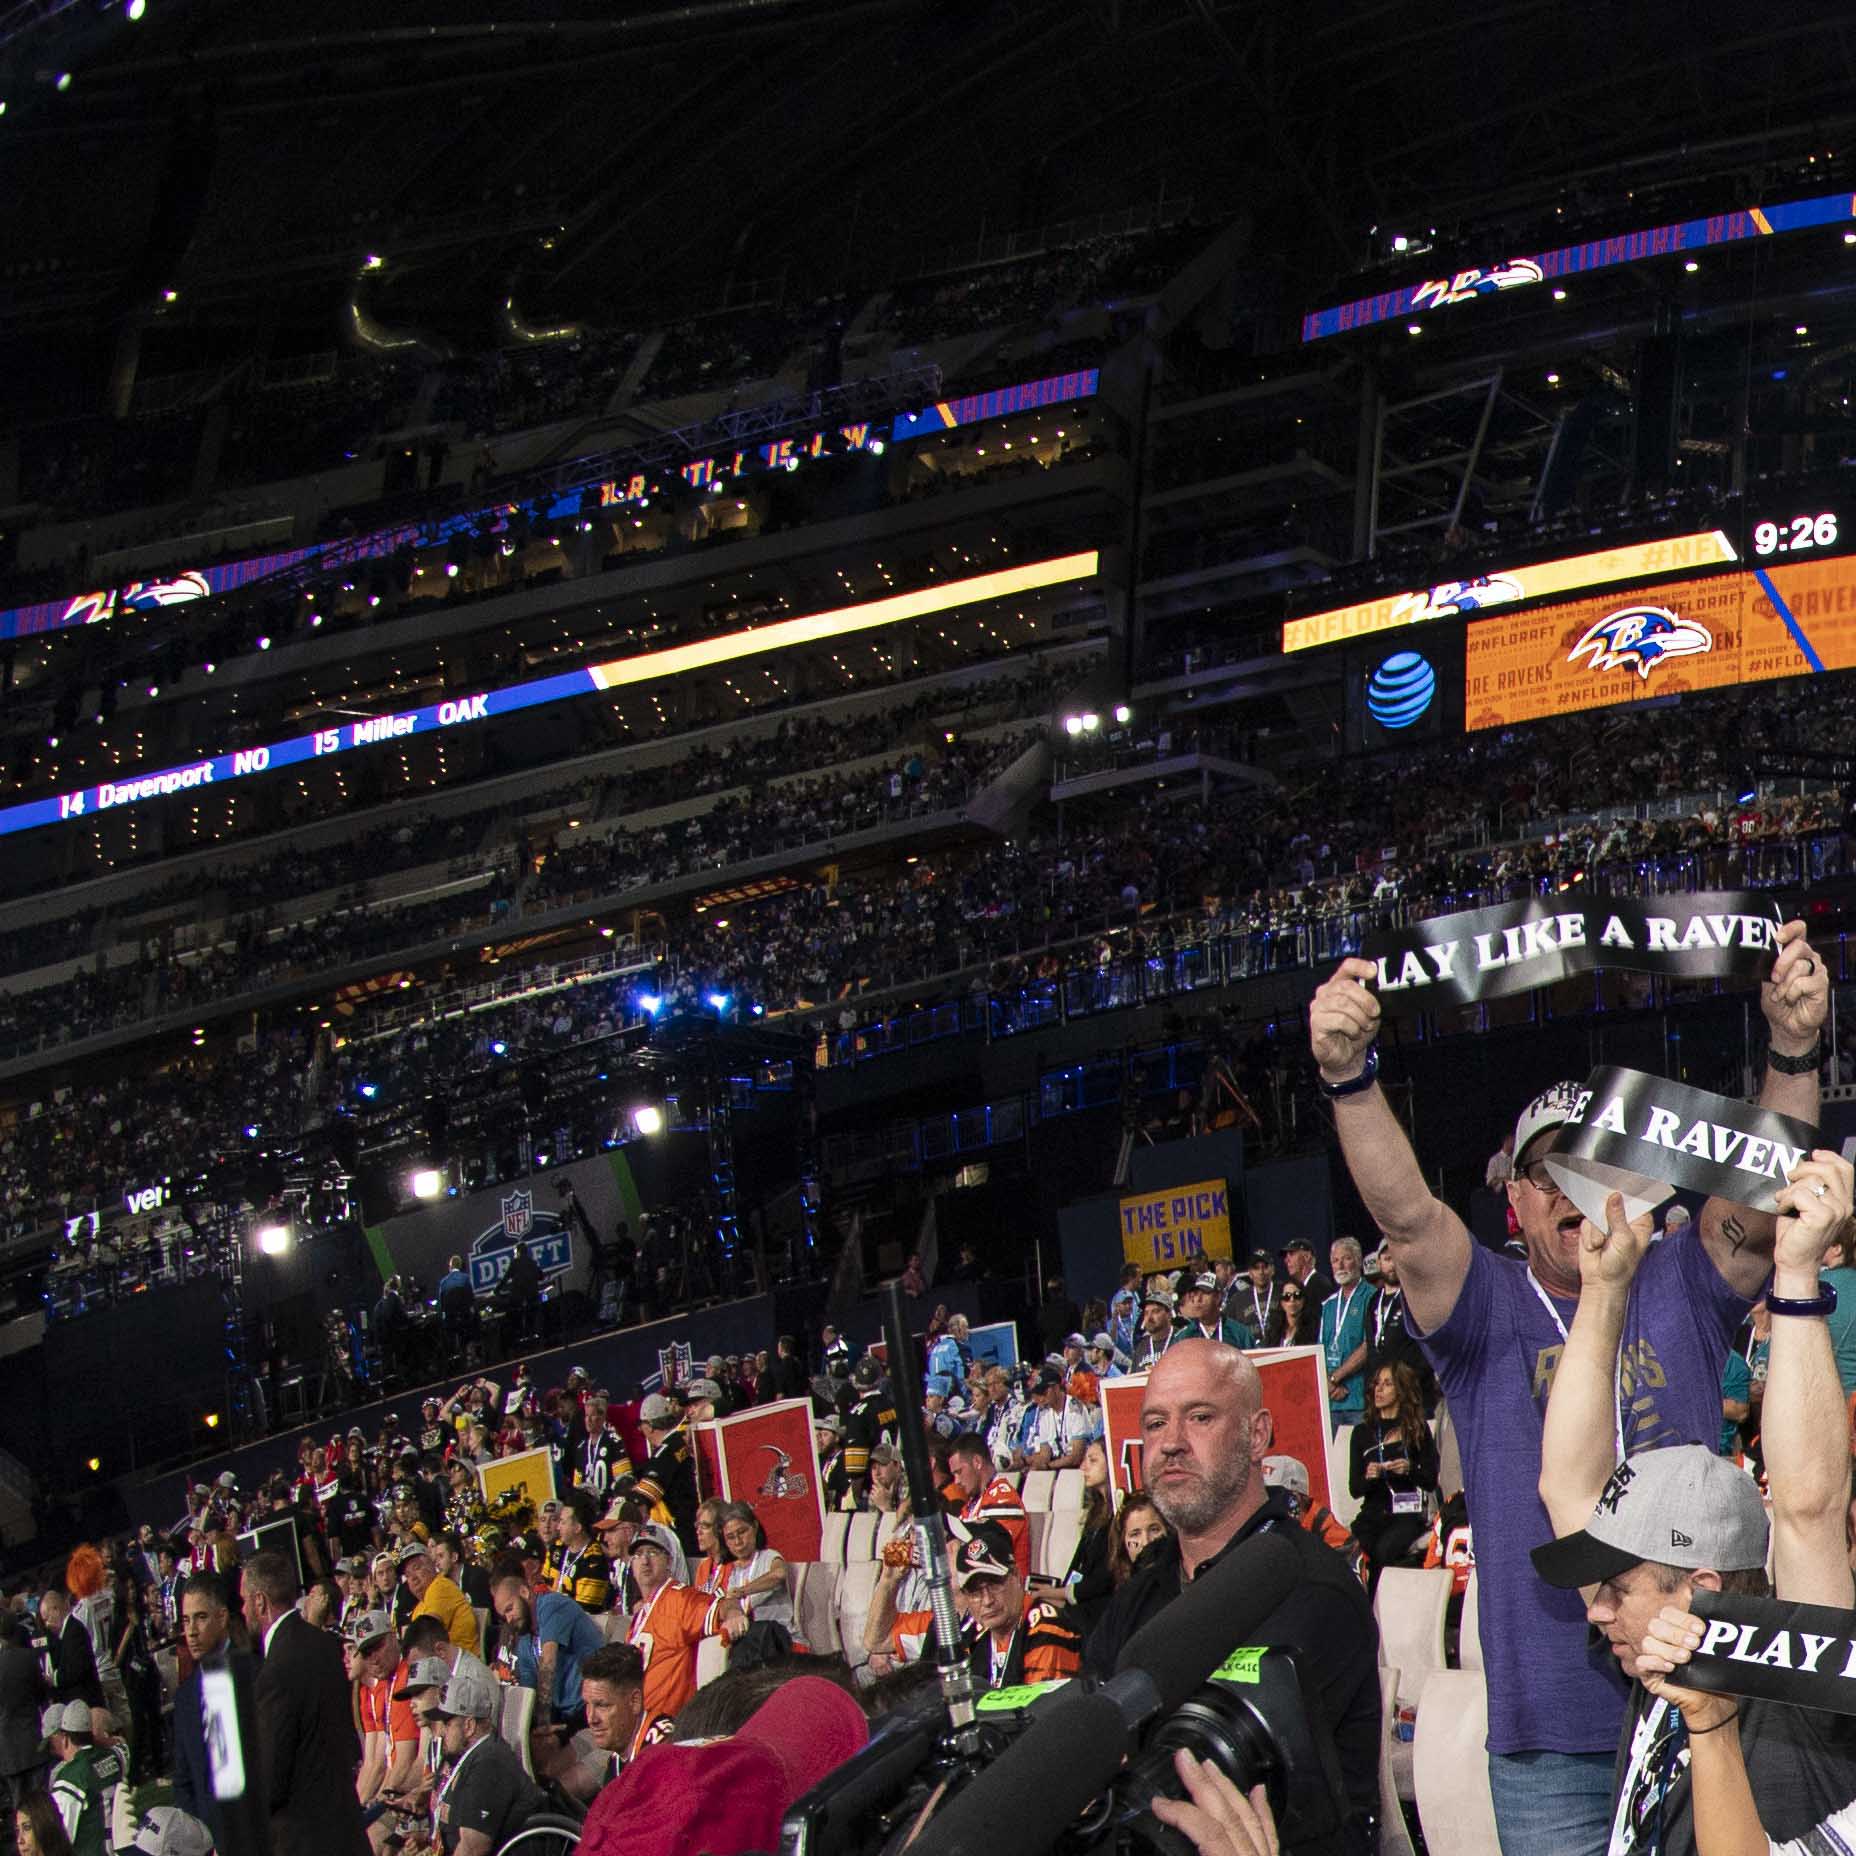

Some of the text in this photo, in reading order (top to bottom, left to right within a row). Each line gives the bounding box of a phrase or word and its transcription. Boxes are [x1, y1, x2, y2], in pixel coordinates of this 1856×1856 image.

[1754, 513, 1838, 555] 9:26
[1469, 624, 1556, 652] #NFLDRAFT
[313, 692, 490, 755] 15 Miller OAK
[58, 747, 270, 818] 14 Davenport NO
[1372, 912, 1783, 991] LAY LIKE A RAVEN
[1593, 1096, 1628, 1135] A
[1642, 1106, 1803, 1186] RAVEN
[506, 1208, 531, 1235] NFL
[1123, 1191, 1226, 1233] THE PICK
[1153, 1228, 1203, 1262] IS IN
[1704, 1625, 1836, 1674] PLAY
